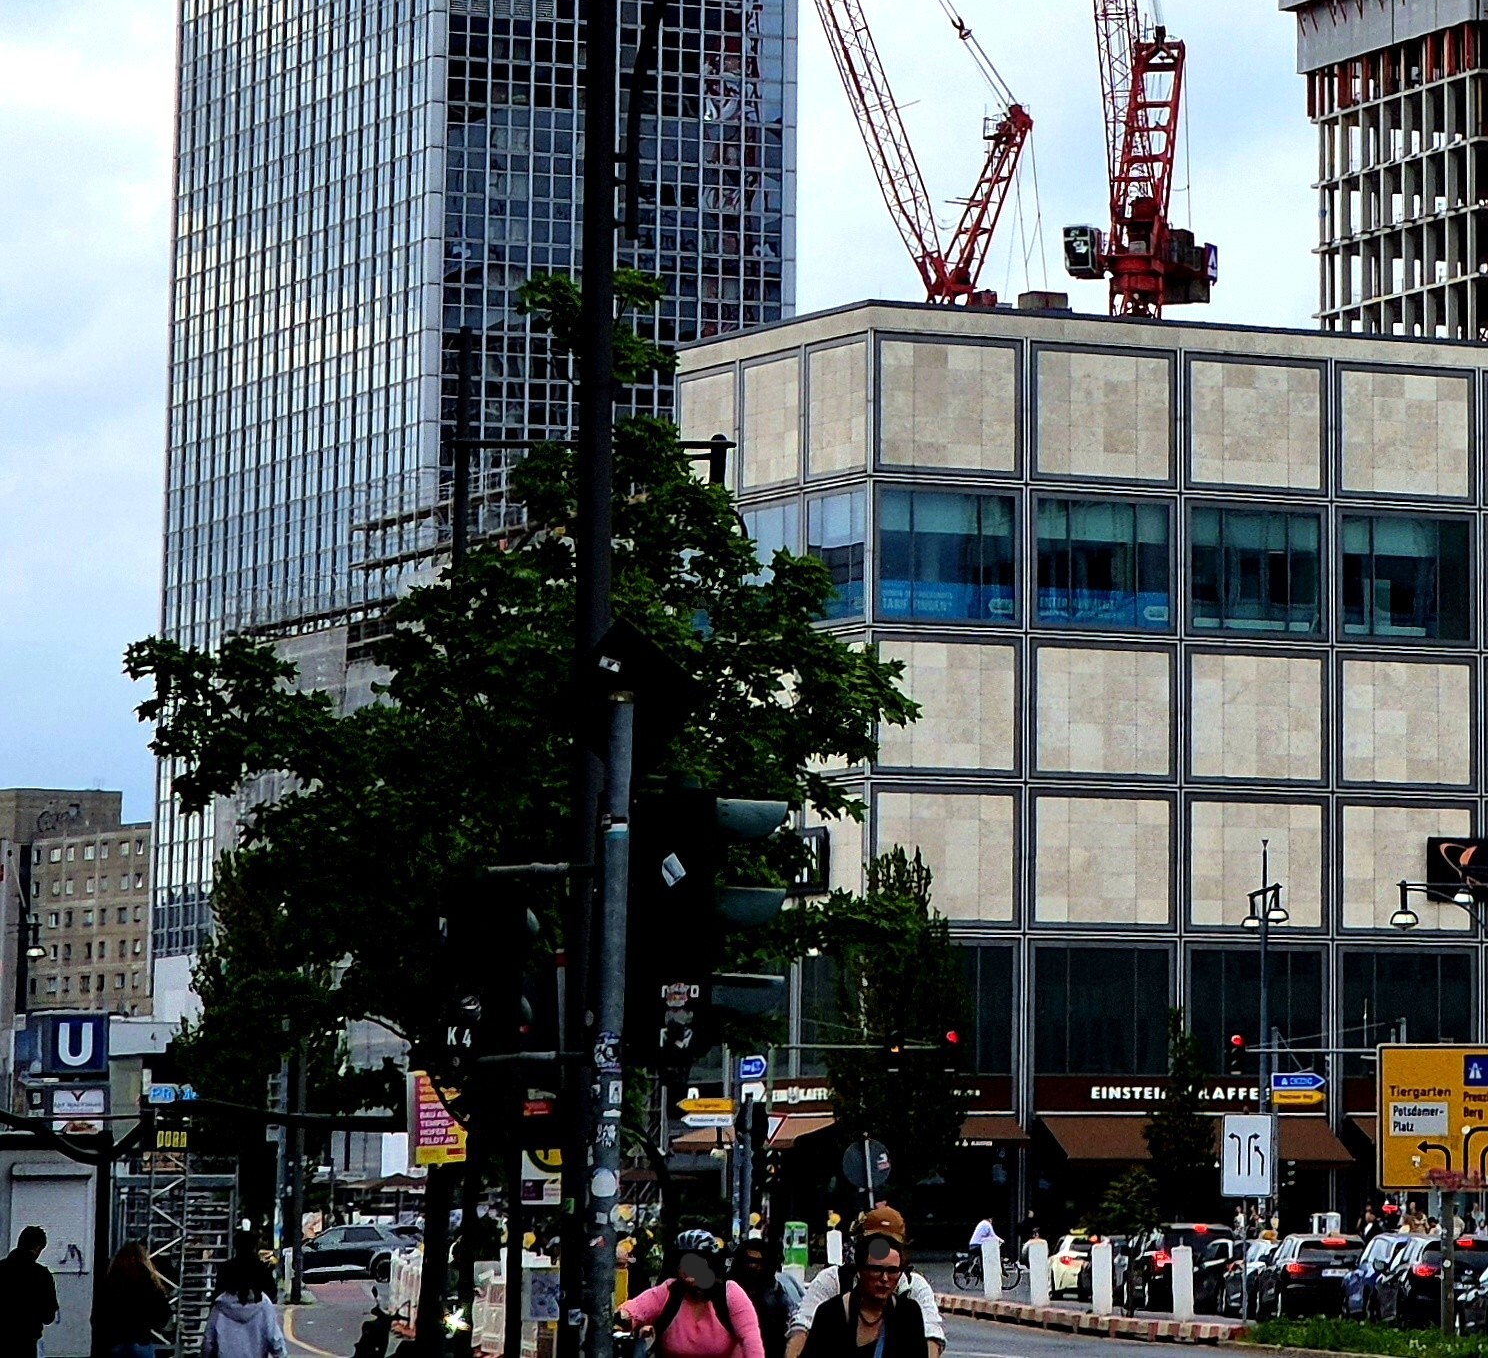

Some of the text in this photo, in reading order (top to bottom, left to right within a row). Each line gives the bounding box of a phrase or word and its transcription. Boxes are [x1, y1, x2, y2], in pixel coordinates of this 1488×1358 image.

[58, 1022, 94, 1066] U
[447, 1027, 472, 1048] K 4
[1389, 1085, 1452, 1100] Tiergarten
[1392, 1105, 1445, 1118] Potsdamer-
[1463, 1106, 1484, 1121] Berg
[1392, 1121, 1415, 1132] Platz
